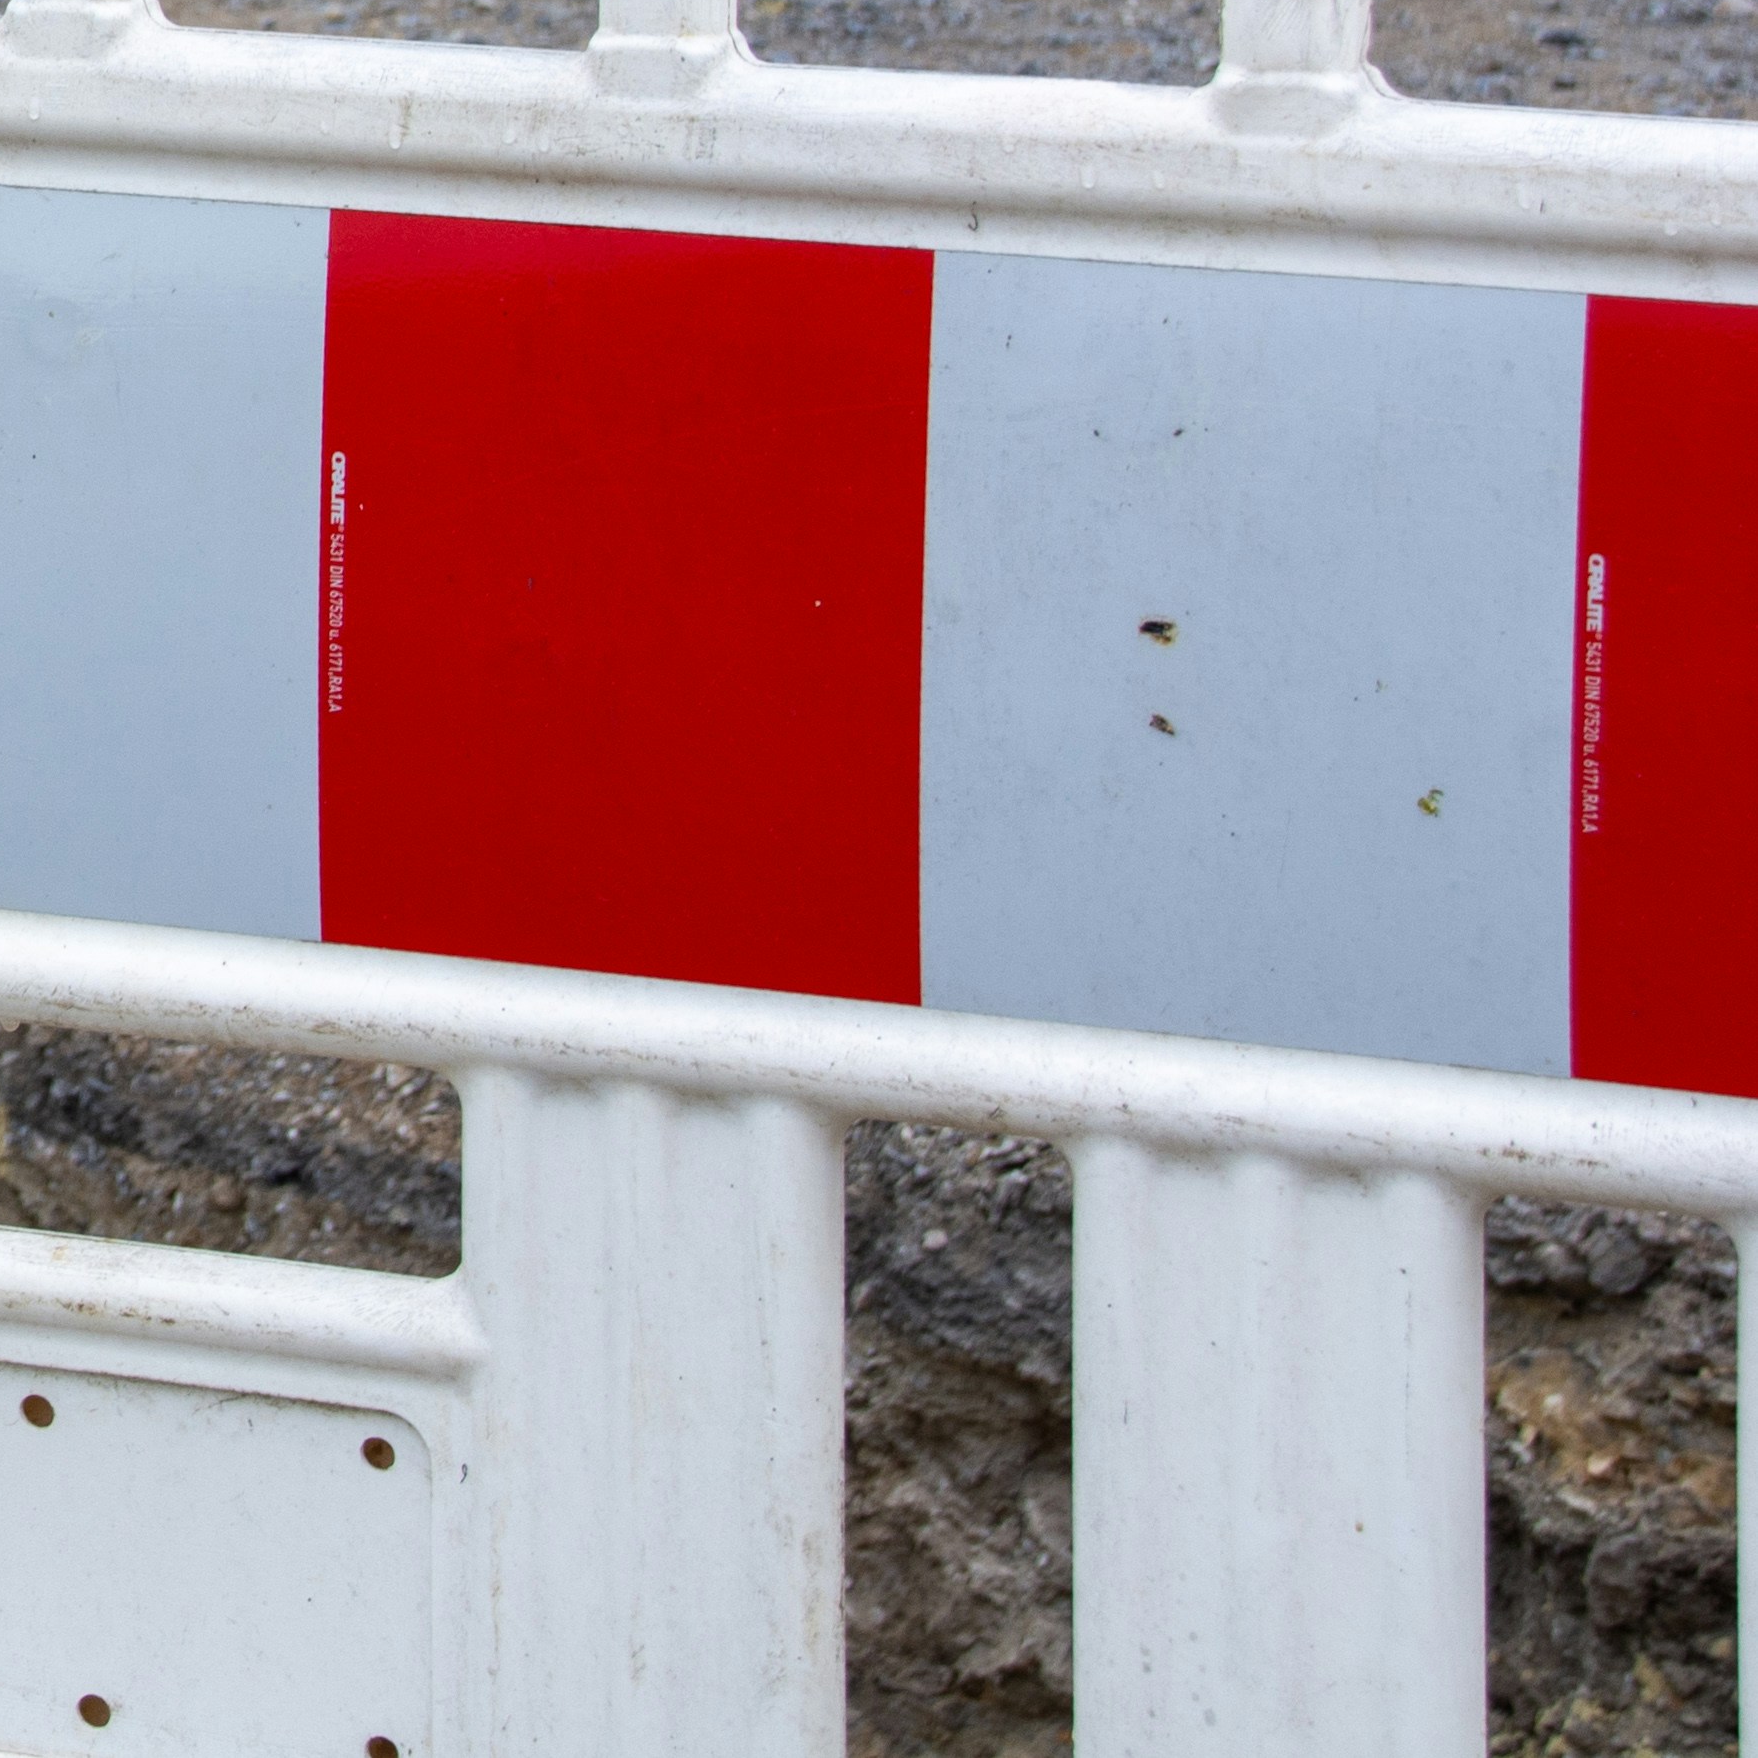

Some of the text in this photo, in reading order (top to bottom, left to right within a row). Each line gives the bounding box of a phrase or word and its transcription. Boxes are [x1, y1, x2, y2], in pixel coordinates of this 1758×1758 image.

[329, 533, 345, 562] 5431
[329, 565, 344, 589] DIN
[329, 589, 344, 628] 67520
[328, 629, 339, 642] u.
[1585, 642, 1602, 672] 5431
[1584, 675, 1601, 701] DIN
[1584, 702, 1601, 742] 67520
[1583, 744, 1595, 757] u.
